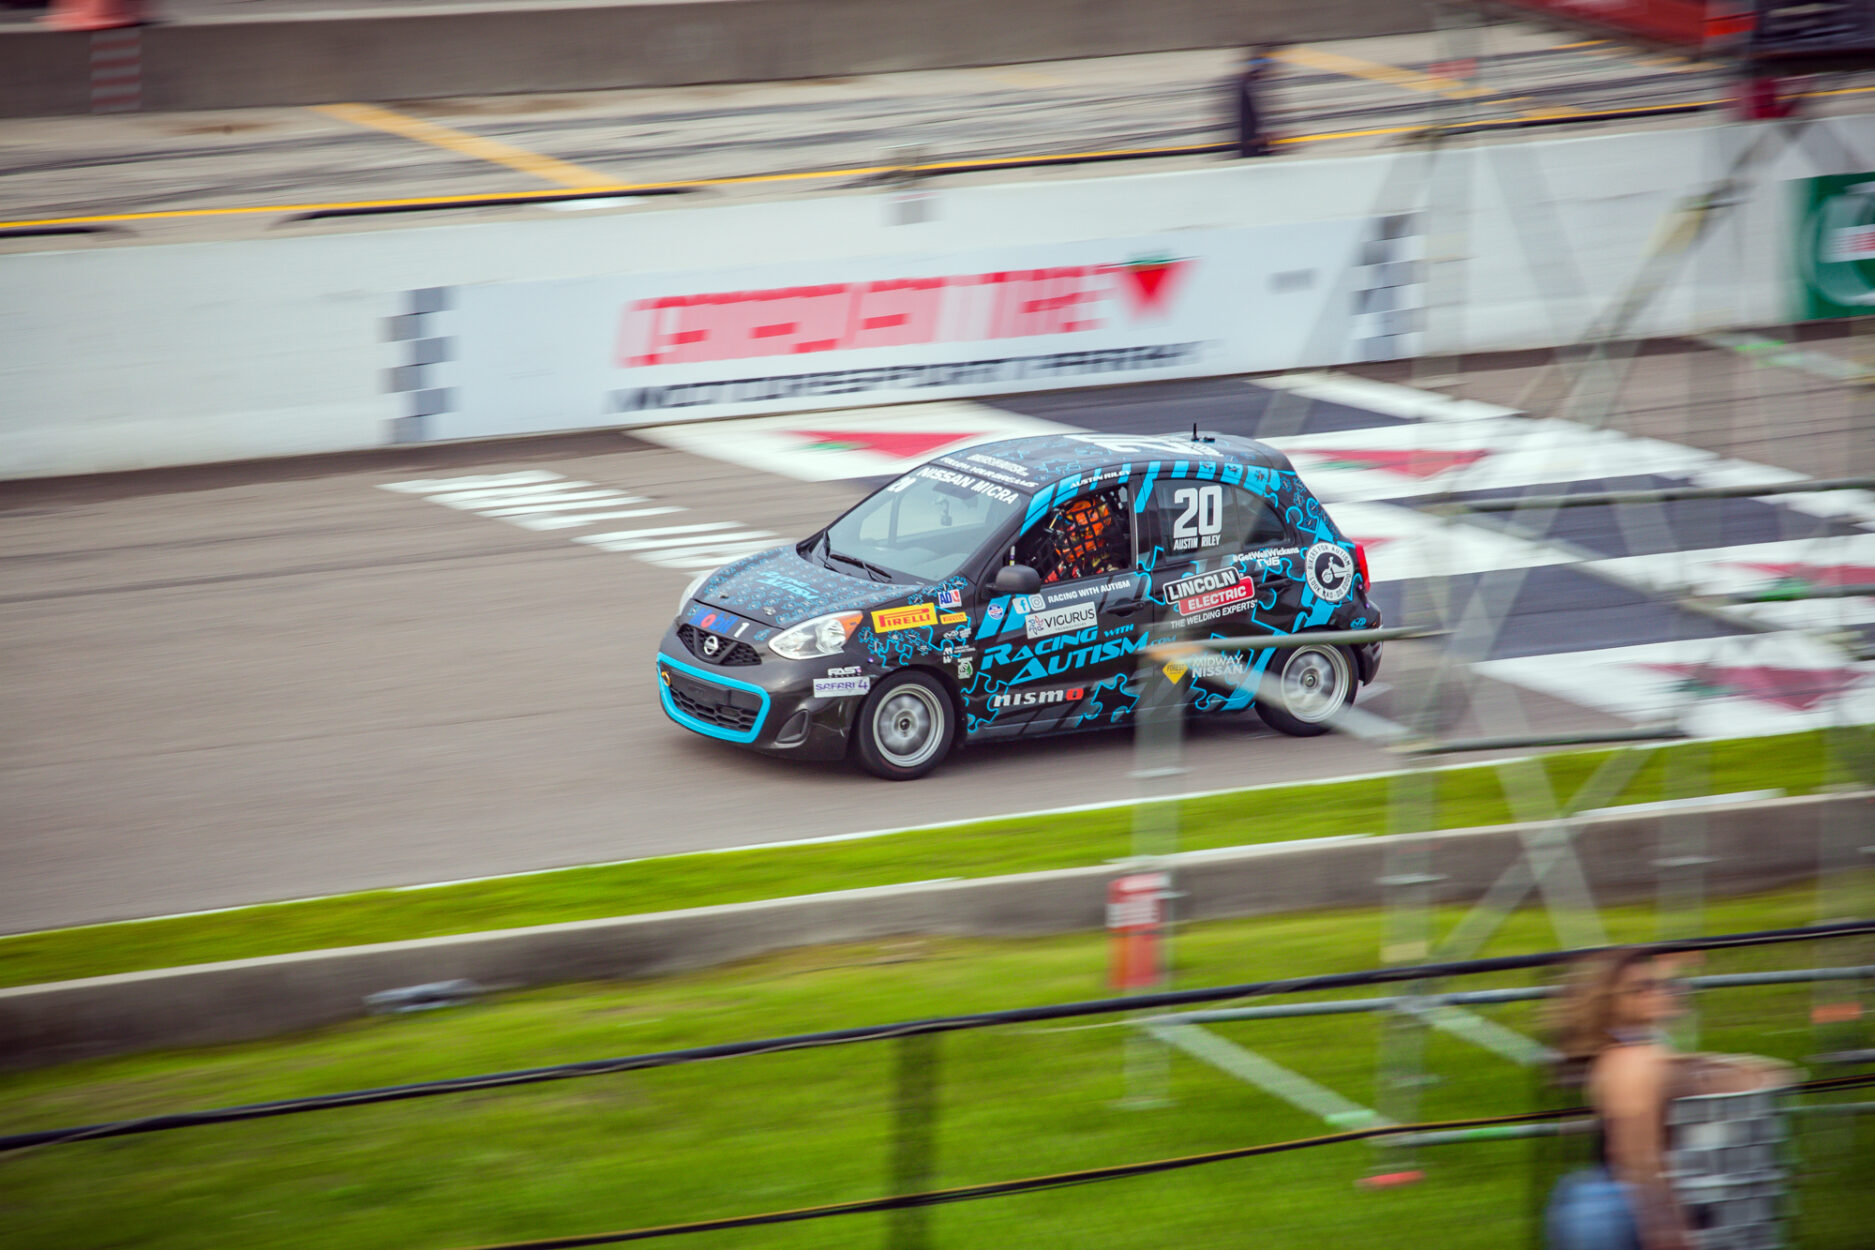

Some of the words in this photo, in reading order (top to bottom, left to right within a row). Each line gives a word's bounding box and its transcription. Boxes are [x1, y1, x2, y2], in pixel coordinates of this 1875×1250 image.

[917, 466, 975, 488] NISSAN
[971, 480, 1019, 505] MICRA
[1070, 475, 1102, 489] AUSTIN
[1102, 469, 1131, 481] RILEY
[1173, 485, 1223, 539] 20
[1173, 537, 1198, 550] AUSTIN
[1201, 534, 1221, 548] RILEY
[1047, 591, 1078, 604] RACING
[1078, 587, 1099, 598] WITH
[1100, 580, 1131, 593] AUTISM
[1168, 570, 1236, 600] LINCOLN
[1187, 585, 1247, 610] ELECTRIC
[690, 607, 738, 635] Mobil
[734, 621, 750, 638] 1
[878, 608, 931, 628] PIRELLI
[1044, 608, 1095, 628] VIGURUS
[1171, 618, 1186, 629] THE
[1187, 609, 1220, 625] WELDING
[1222, 600, 1256, 616] EXPERTS
[980, 626, 1098, 670] RACING
[1104, 624, 1134, 638] WITH
[1007, 631, 1149, 686] AUTISM
[1191, 654, 1244, 668] MIDWAY
[1191, 664, 1244, 678] NISSAN
[858, 679, 868, 690] 4
